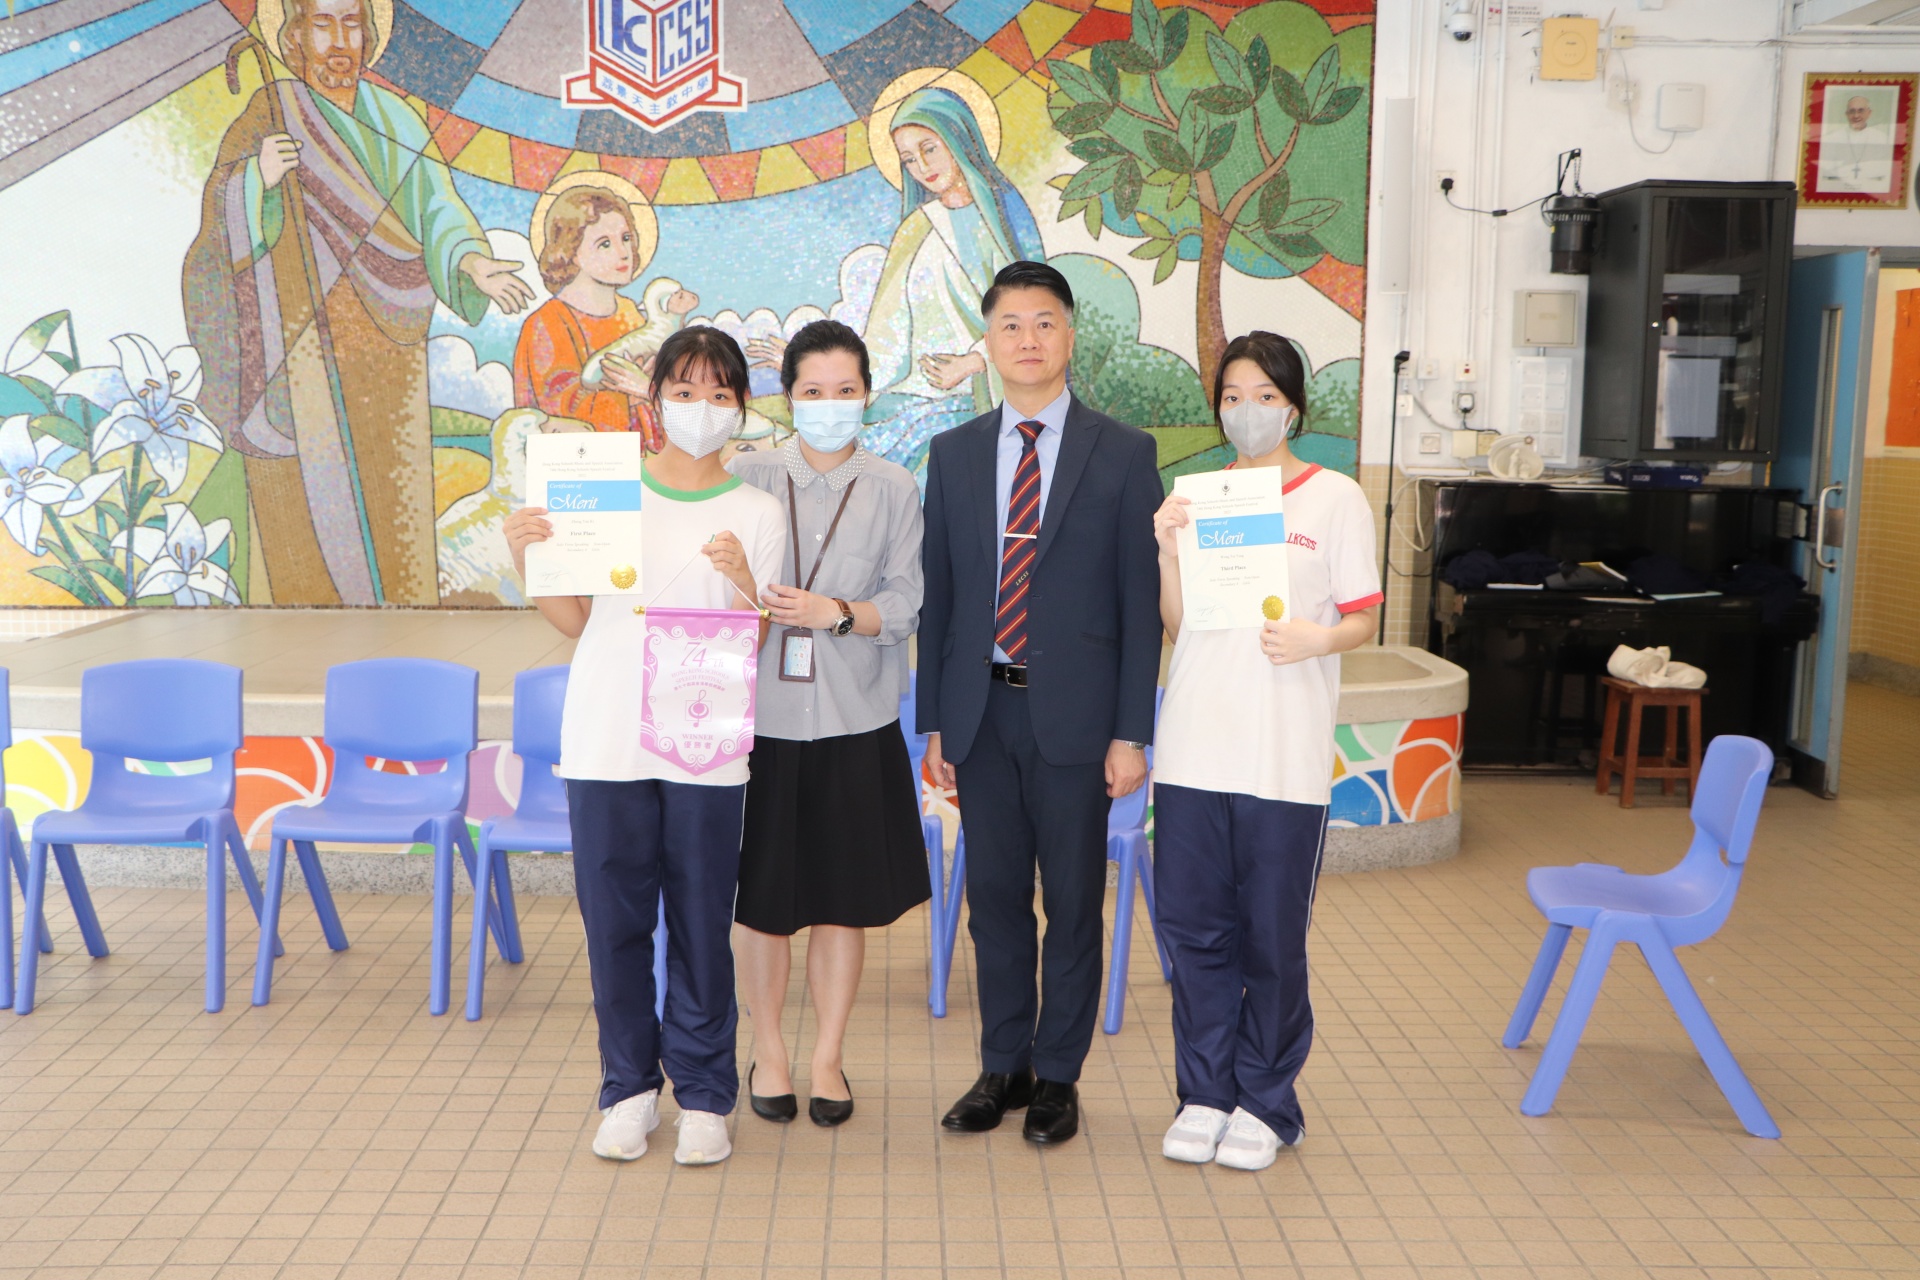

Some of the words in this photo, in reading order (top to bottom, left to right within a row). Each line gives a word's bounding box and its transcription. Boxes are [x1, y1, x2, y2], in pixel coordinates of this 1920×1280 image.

[550, 494, 599, 510] Merit
[1200, 530, 1245, 547] Merit
[1285, 532, 1317, 550] LKCSS
[681, 642, 707, 668] 74
[682, 733, 714, 741] WINNER
